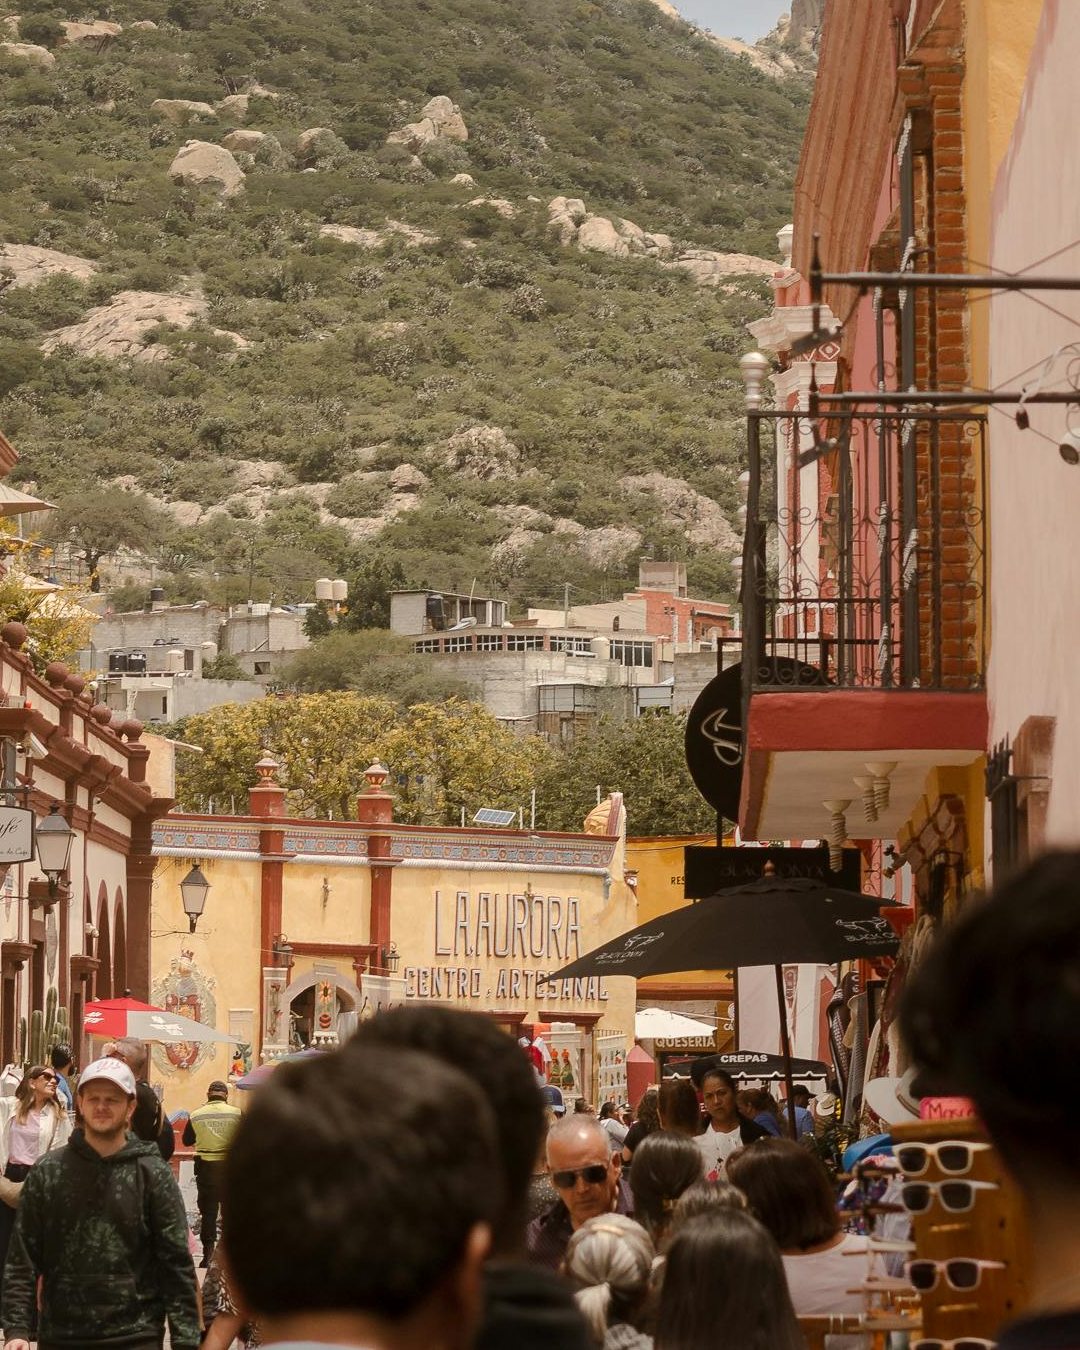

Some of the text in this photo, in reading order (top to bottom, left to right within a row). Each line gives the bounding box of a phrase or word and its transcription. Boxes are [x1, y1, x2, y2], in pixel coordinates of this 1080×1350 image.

[435, 891, 582, 960] LA AURORA
[405, 967, 482, 998] CENTRO
[720, 1055, 768, 1063] CREPAS
